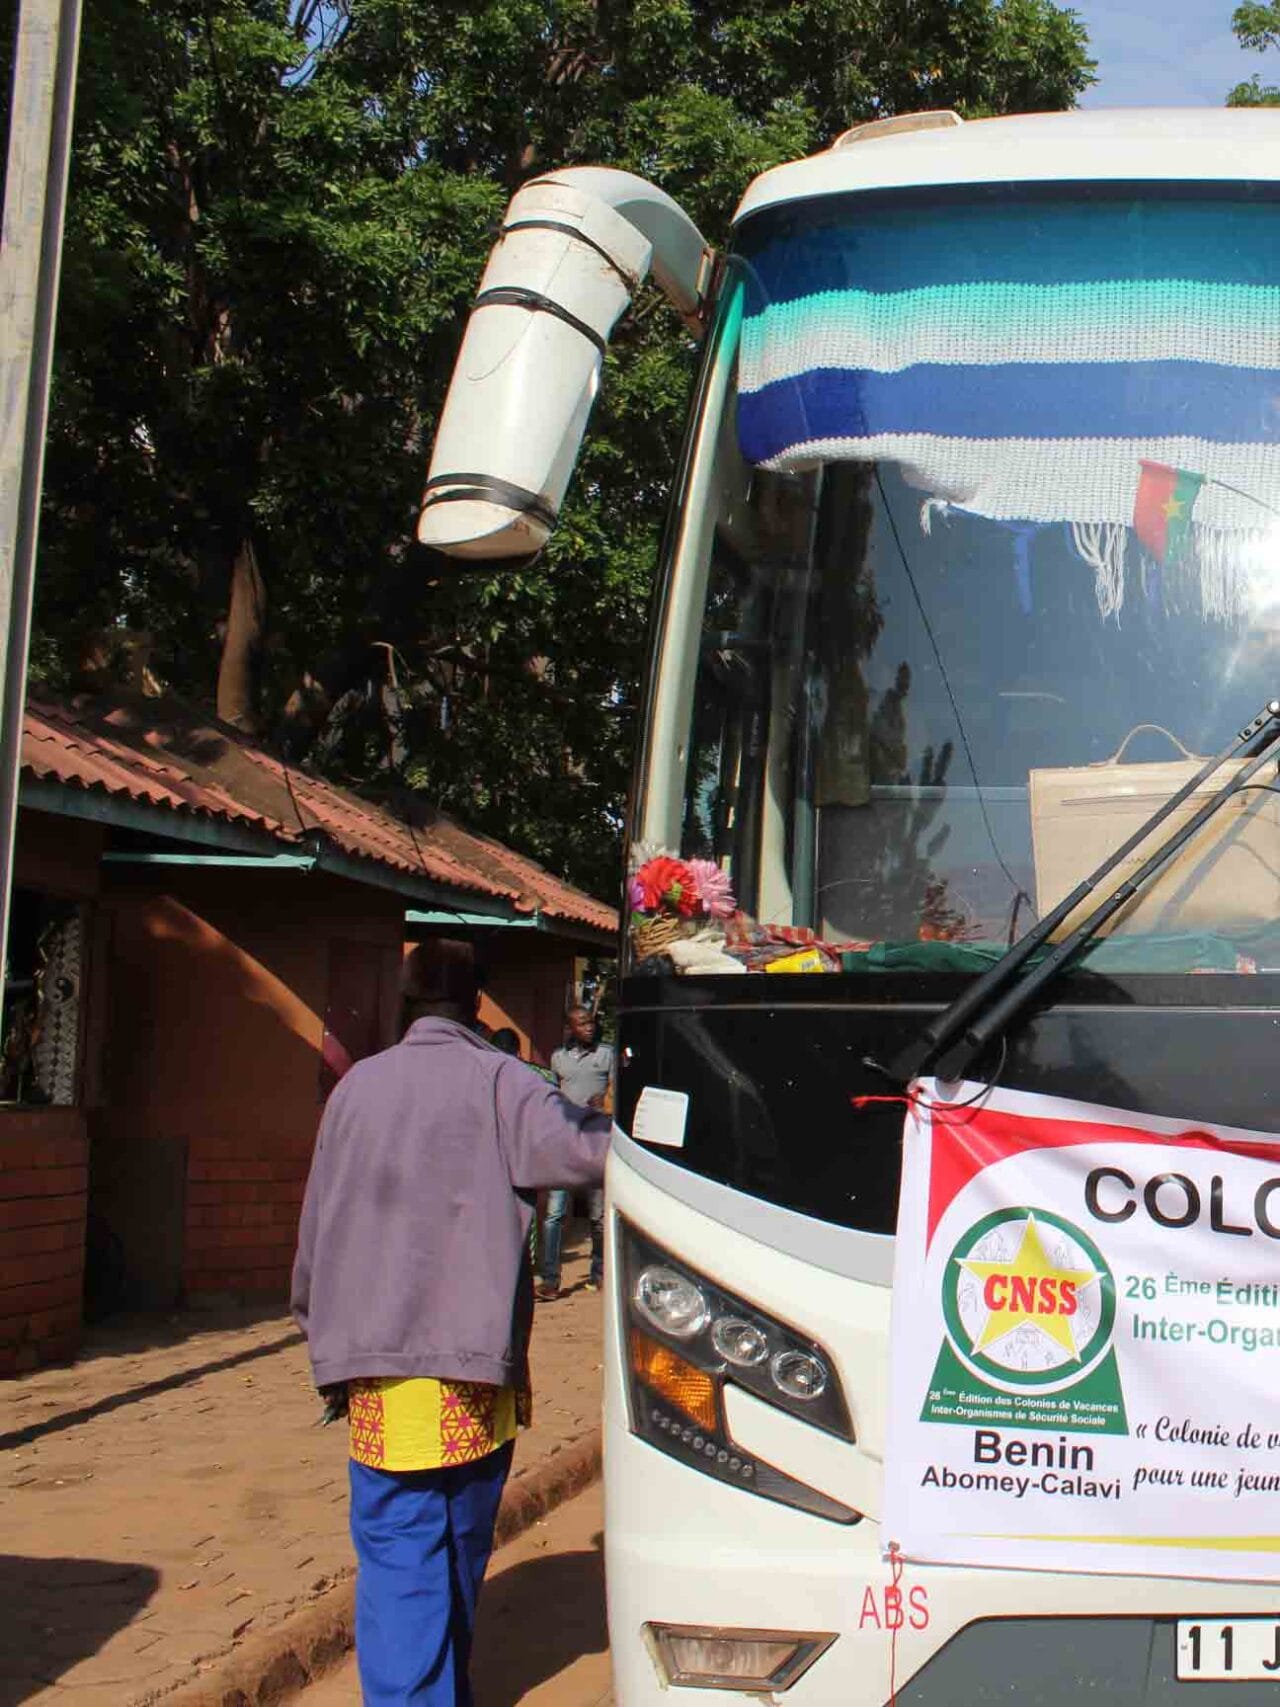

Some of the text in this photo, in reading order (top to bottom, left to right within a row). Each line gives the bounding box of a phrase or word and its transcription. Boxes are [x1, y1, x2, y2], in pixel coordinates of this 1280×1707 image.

[983, 1273, 1078, 1316] CNSS
[1125, 1275, 1156, 1299] 26
[931, 1404, 1106, 1425] Inter-Organismes de Sécurité Sociale
[995, 1396, 1011, 1406] des
[1014, 1396, 1056, 1410] Colonies
[1059, 1400, 1071, 1410] de
[1073, 1401, 1119, 1413] Vacances
[1154, 1415, 1229, 1447] Colonie
[1236, 1423, 1261, 1449] de
[974, 1430, 1094, 1471] Benin
[920, 1466, 1121, 1499] Abomey-Calavi
[1132, 1466, 1184, 1490] pour
[1191, 1469, 1228, 1489] une
[859, 1585, 929, 1630] ABS
[1188, 1625, 1234, 1671] 11
